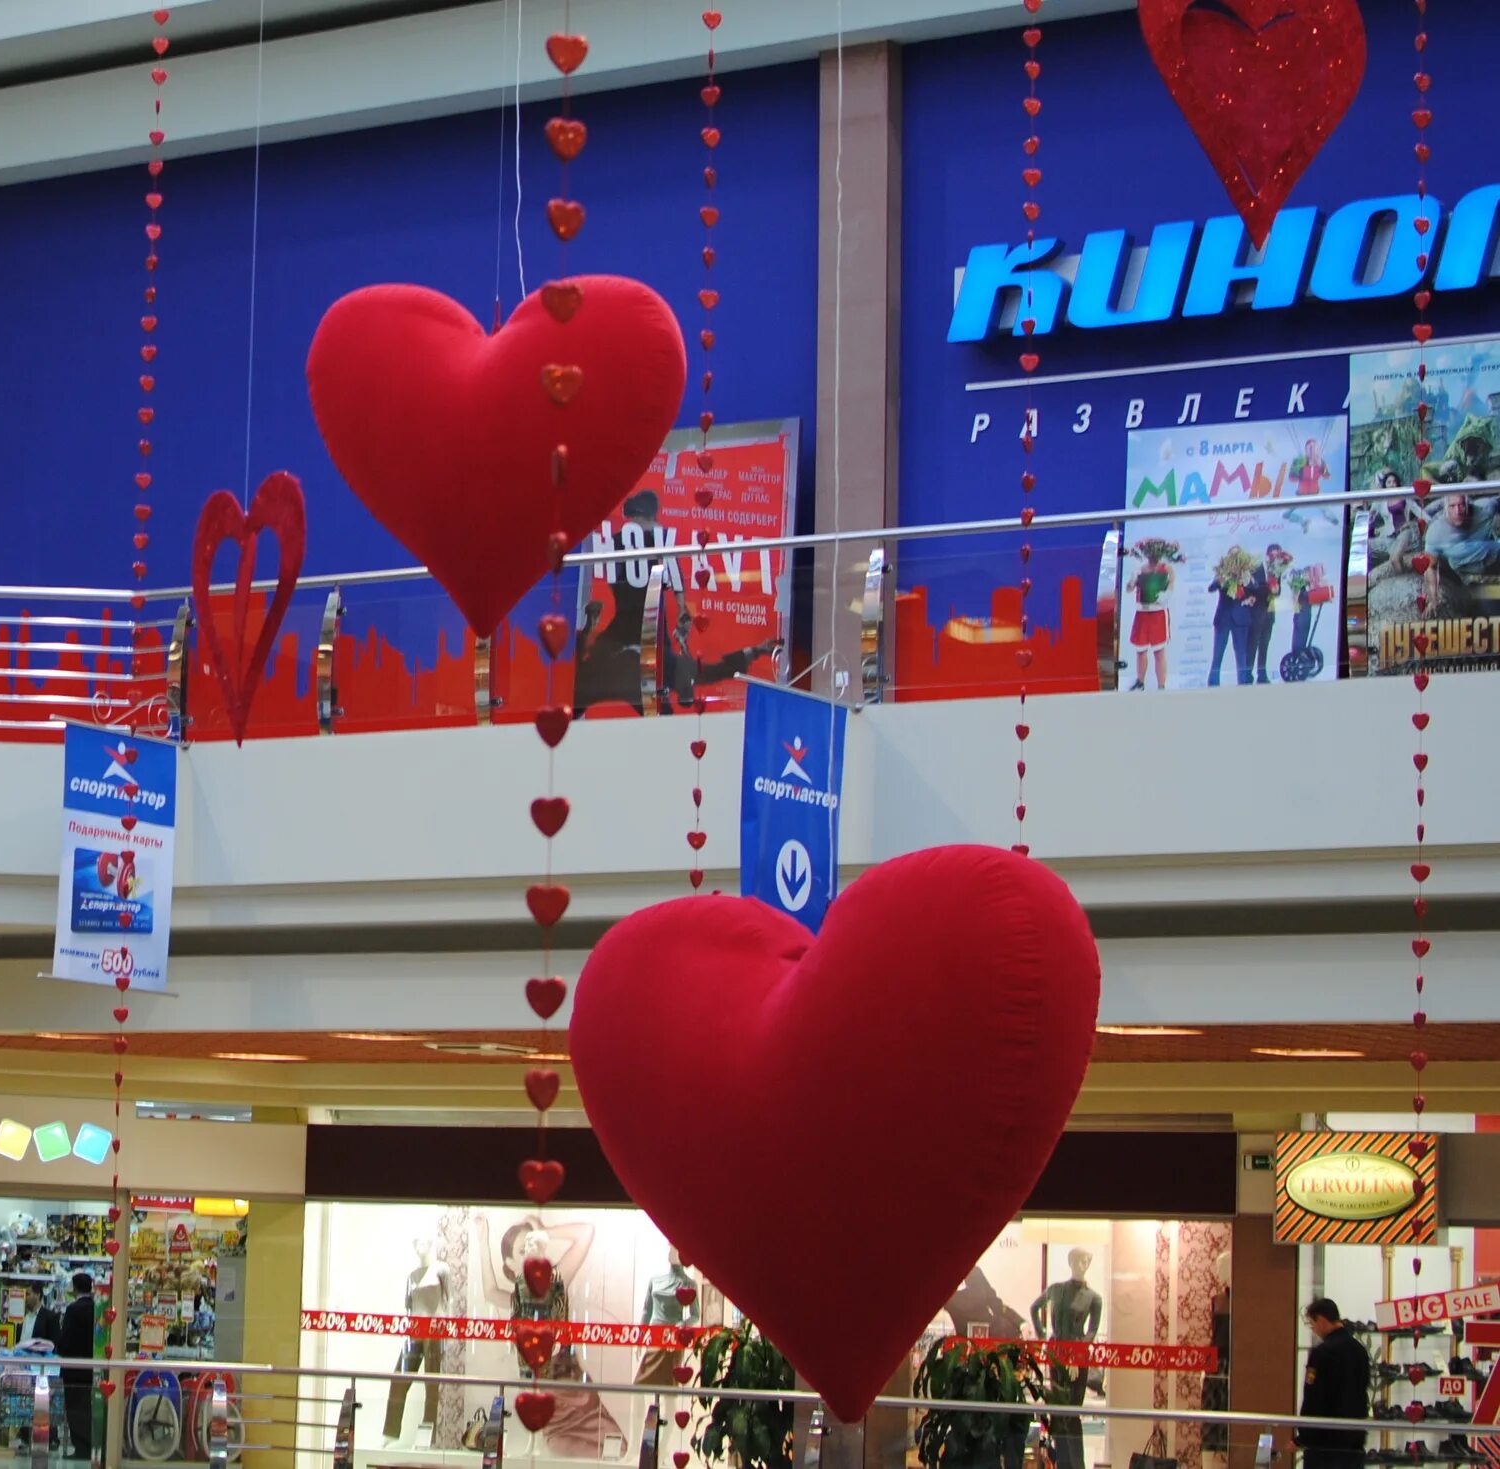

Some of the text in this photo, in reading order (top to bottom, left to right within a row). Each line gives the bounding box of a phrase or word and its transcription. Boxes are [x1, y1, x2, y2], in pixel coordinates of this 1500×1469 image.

[970, 381, 1350, 444] РАЗВЛЕК
[1199, 441, 1209, 456] 8
[1212, 442, 1254, 455] МАРТА
[1131, 460, 1288, 508] МАМЫ
[691, 506, 725, 522] СТИВЕН
[728, 510, 778, 527] СОДЕРБЕРГ
[702, 599, 767, 615] ЕЙ НЕ ОСТАВИЛИ
[736, 614, 767, 626] ВЫБОРА
[754, 775, 838, 809] спортмастер
[68, 820, 163, 849] Подарочные карты
[101, 948, 134, 977] 500
[1299, 1177, 1410, 1197] TERVOLINA
[1399, 1291, 1493, 1325] BIG SALE
[1442, 1379, 1463, 1395] ДО
